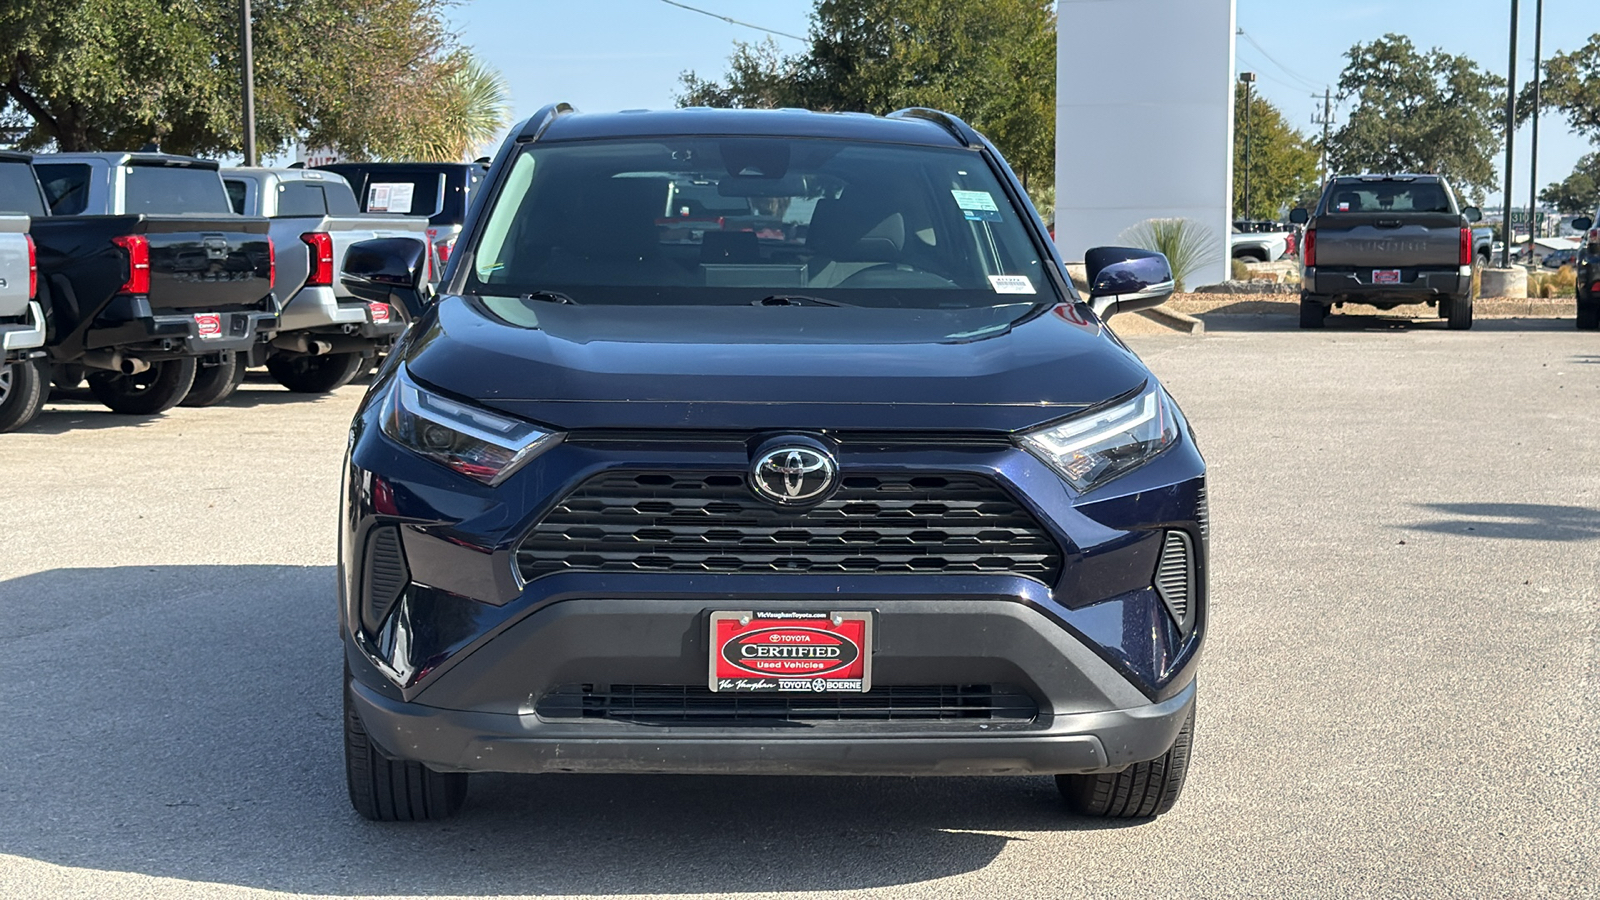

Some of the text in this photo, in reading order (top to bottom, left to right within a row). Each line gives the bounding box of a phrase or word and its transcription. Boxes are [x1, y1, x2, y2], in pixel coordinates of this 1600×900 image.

[741, 644, 840, 657] CERTIFIED
[784, 661, 824, 669] Vehicles
[735, 679, 776, 691] Vaughan
